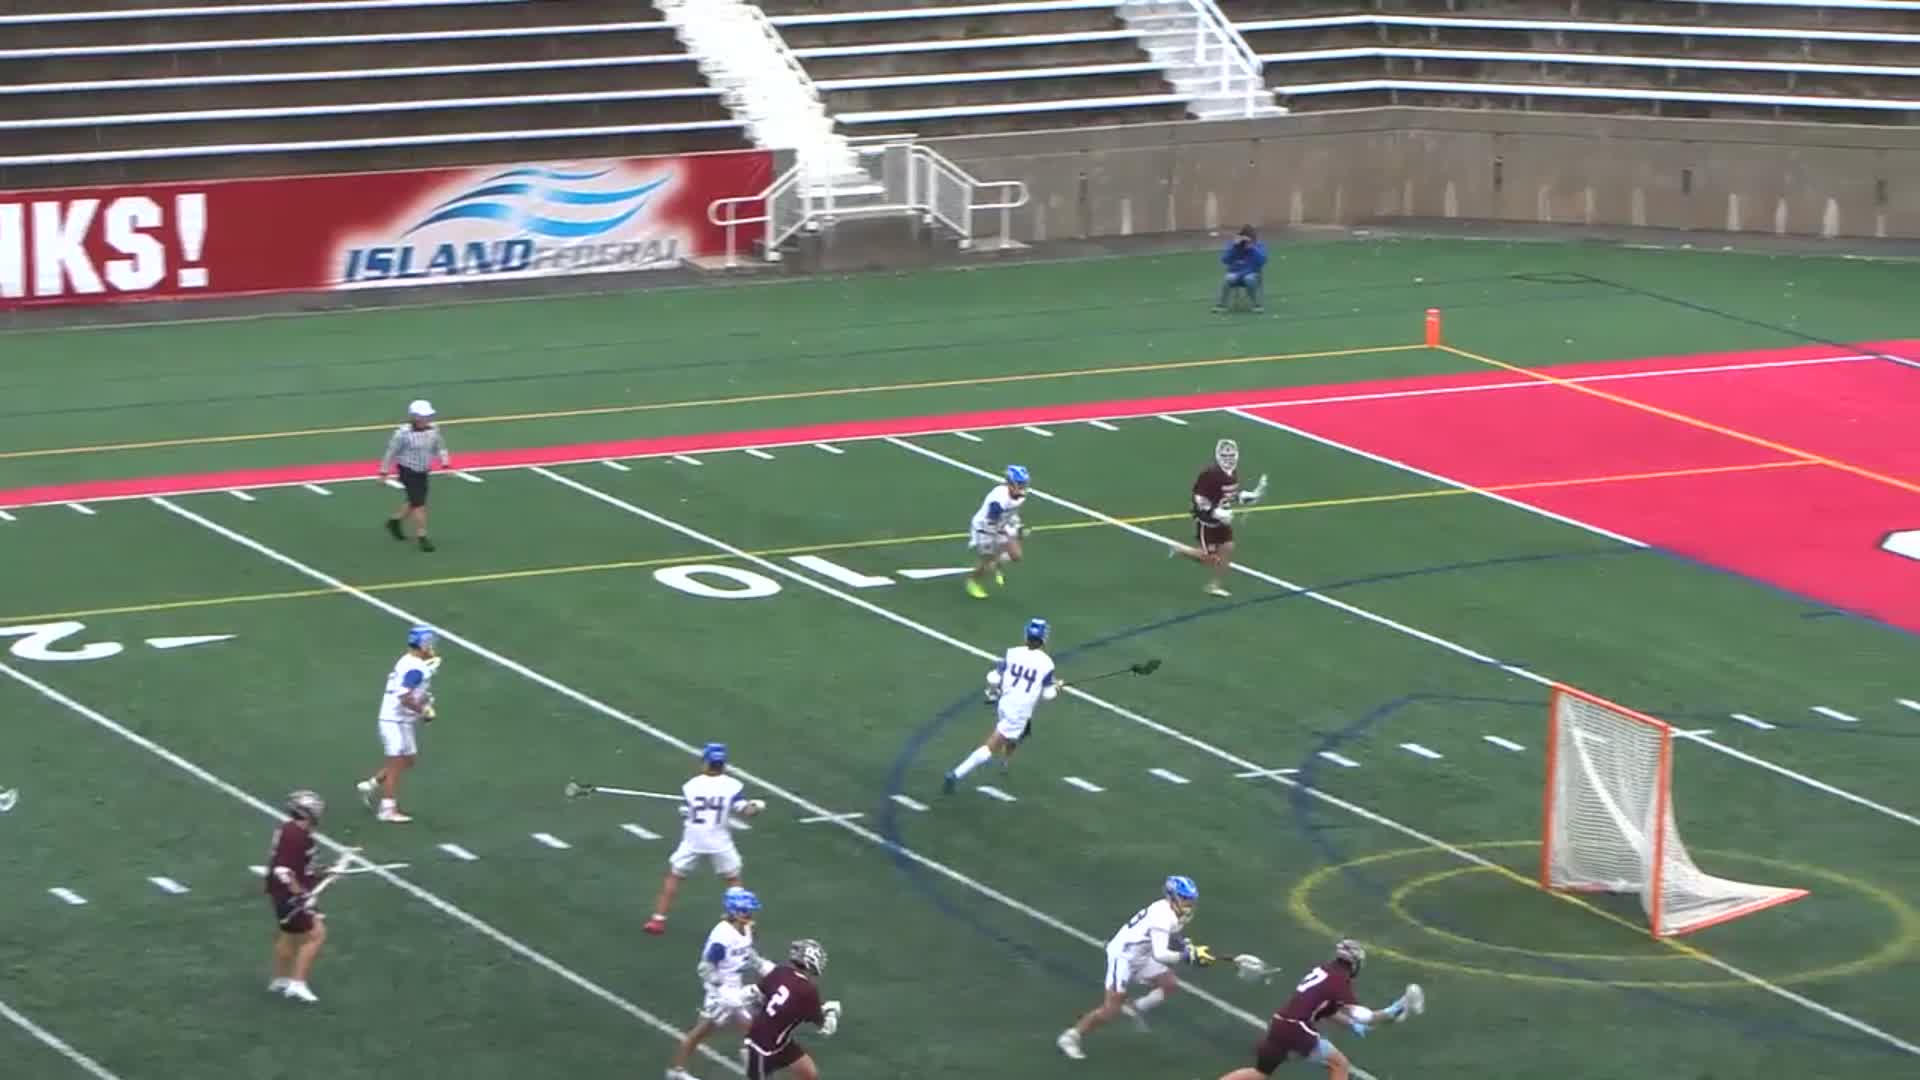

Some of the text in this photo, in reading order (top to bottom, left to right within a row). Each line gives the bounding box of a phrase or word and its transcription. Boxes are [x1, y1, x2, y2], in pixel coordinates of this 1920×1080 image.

[344, 239, 534, 283] ISLAND
[1010, 663, 1038, 693] 44
[692, 796, 724, 825] 24
[765, 984, 791, 1017] 2
